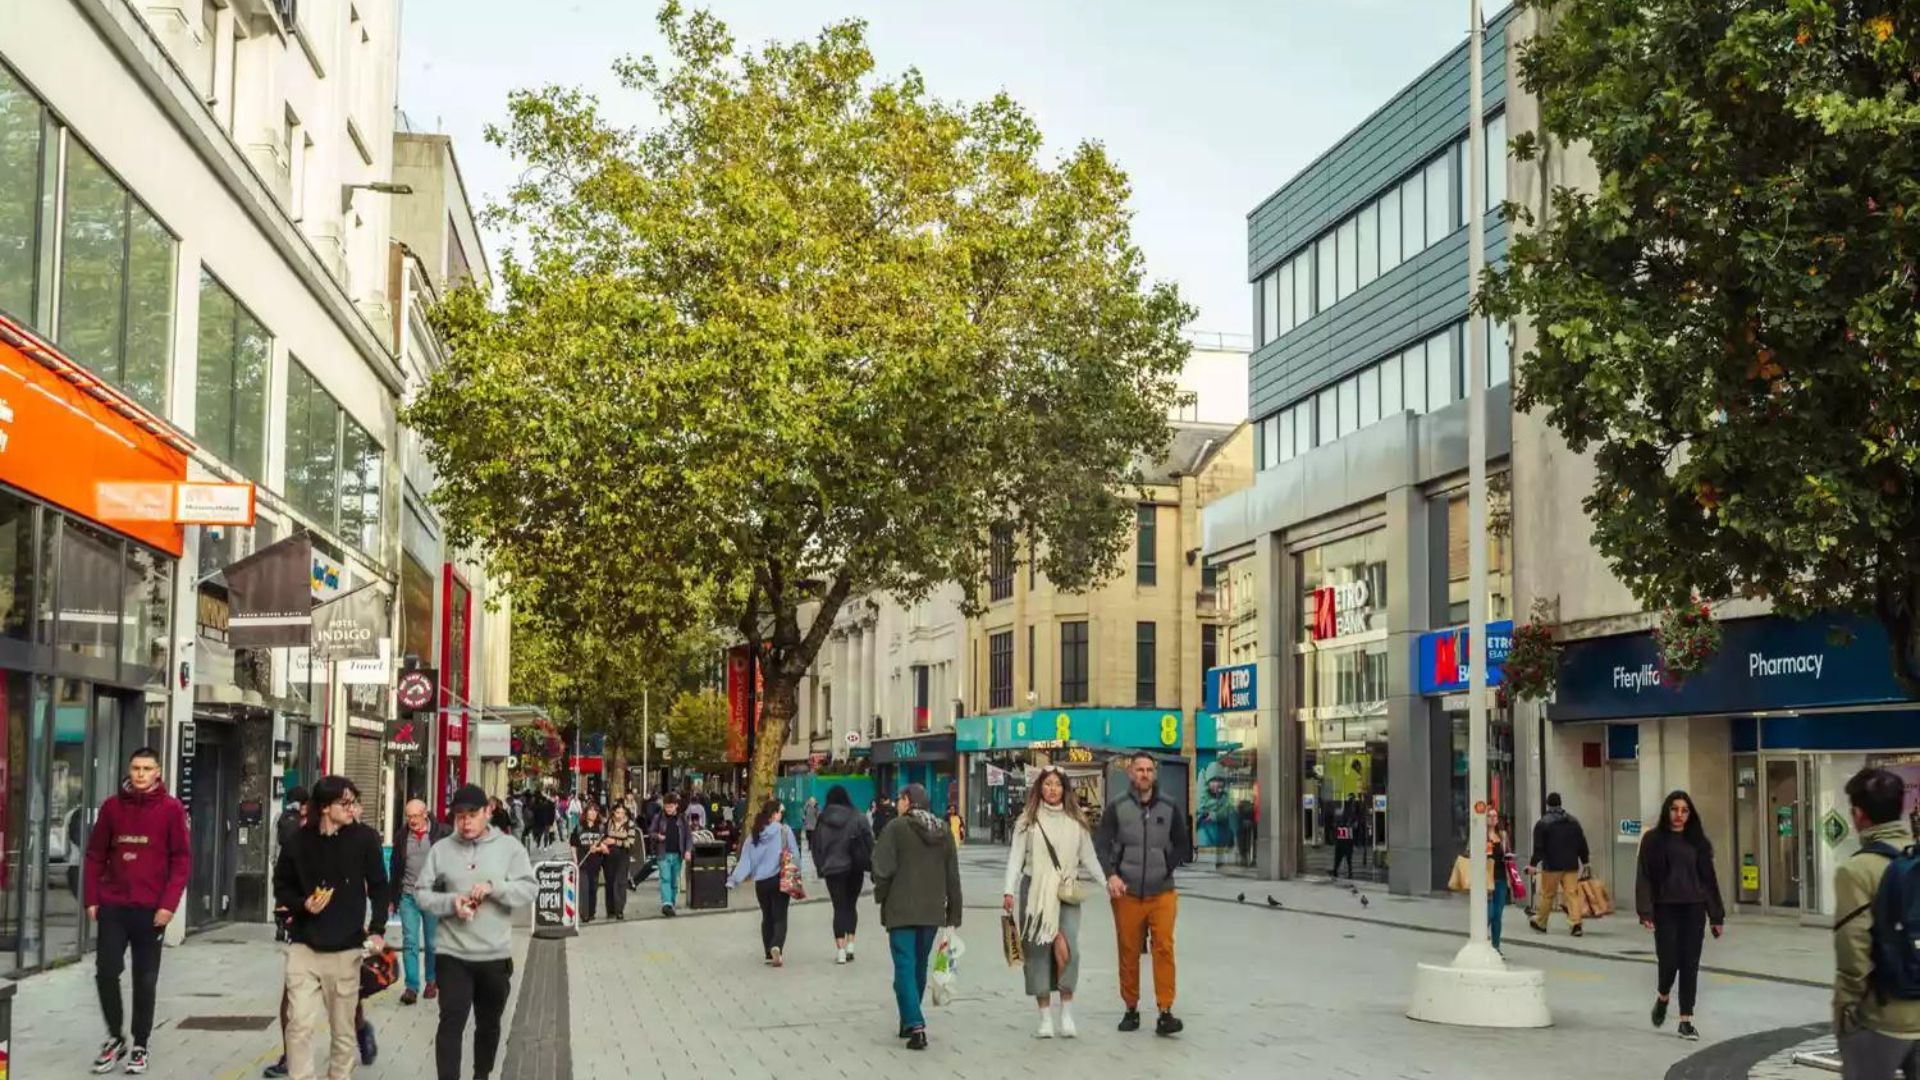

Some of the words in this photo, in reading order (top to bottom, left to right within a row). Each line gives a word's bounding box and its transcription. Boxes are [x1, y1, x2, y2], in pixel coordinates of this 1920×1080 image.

[329, 619, 358, 627] HOTEL
[1336, 611, 1366, 636] BANK
[317, 628, 371, 641] INDIGO
[1749, 653, 1823, 679] Pharmacy
[1232, 692, 1250, 707] BANK
[540, 879, 561, 891] Shop
[539, 892, 560, 909] OPEN
